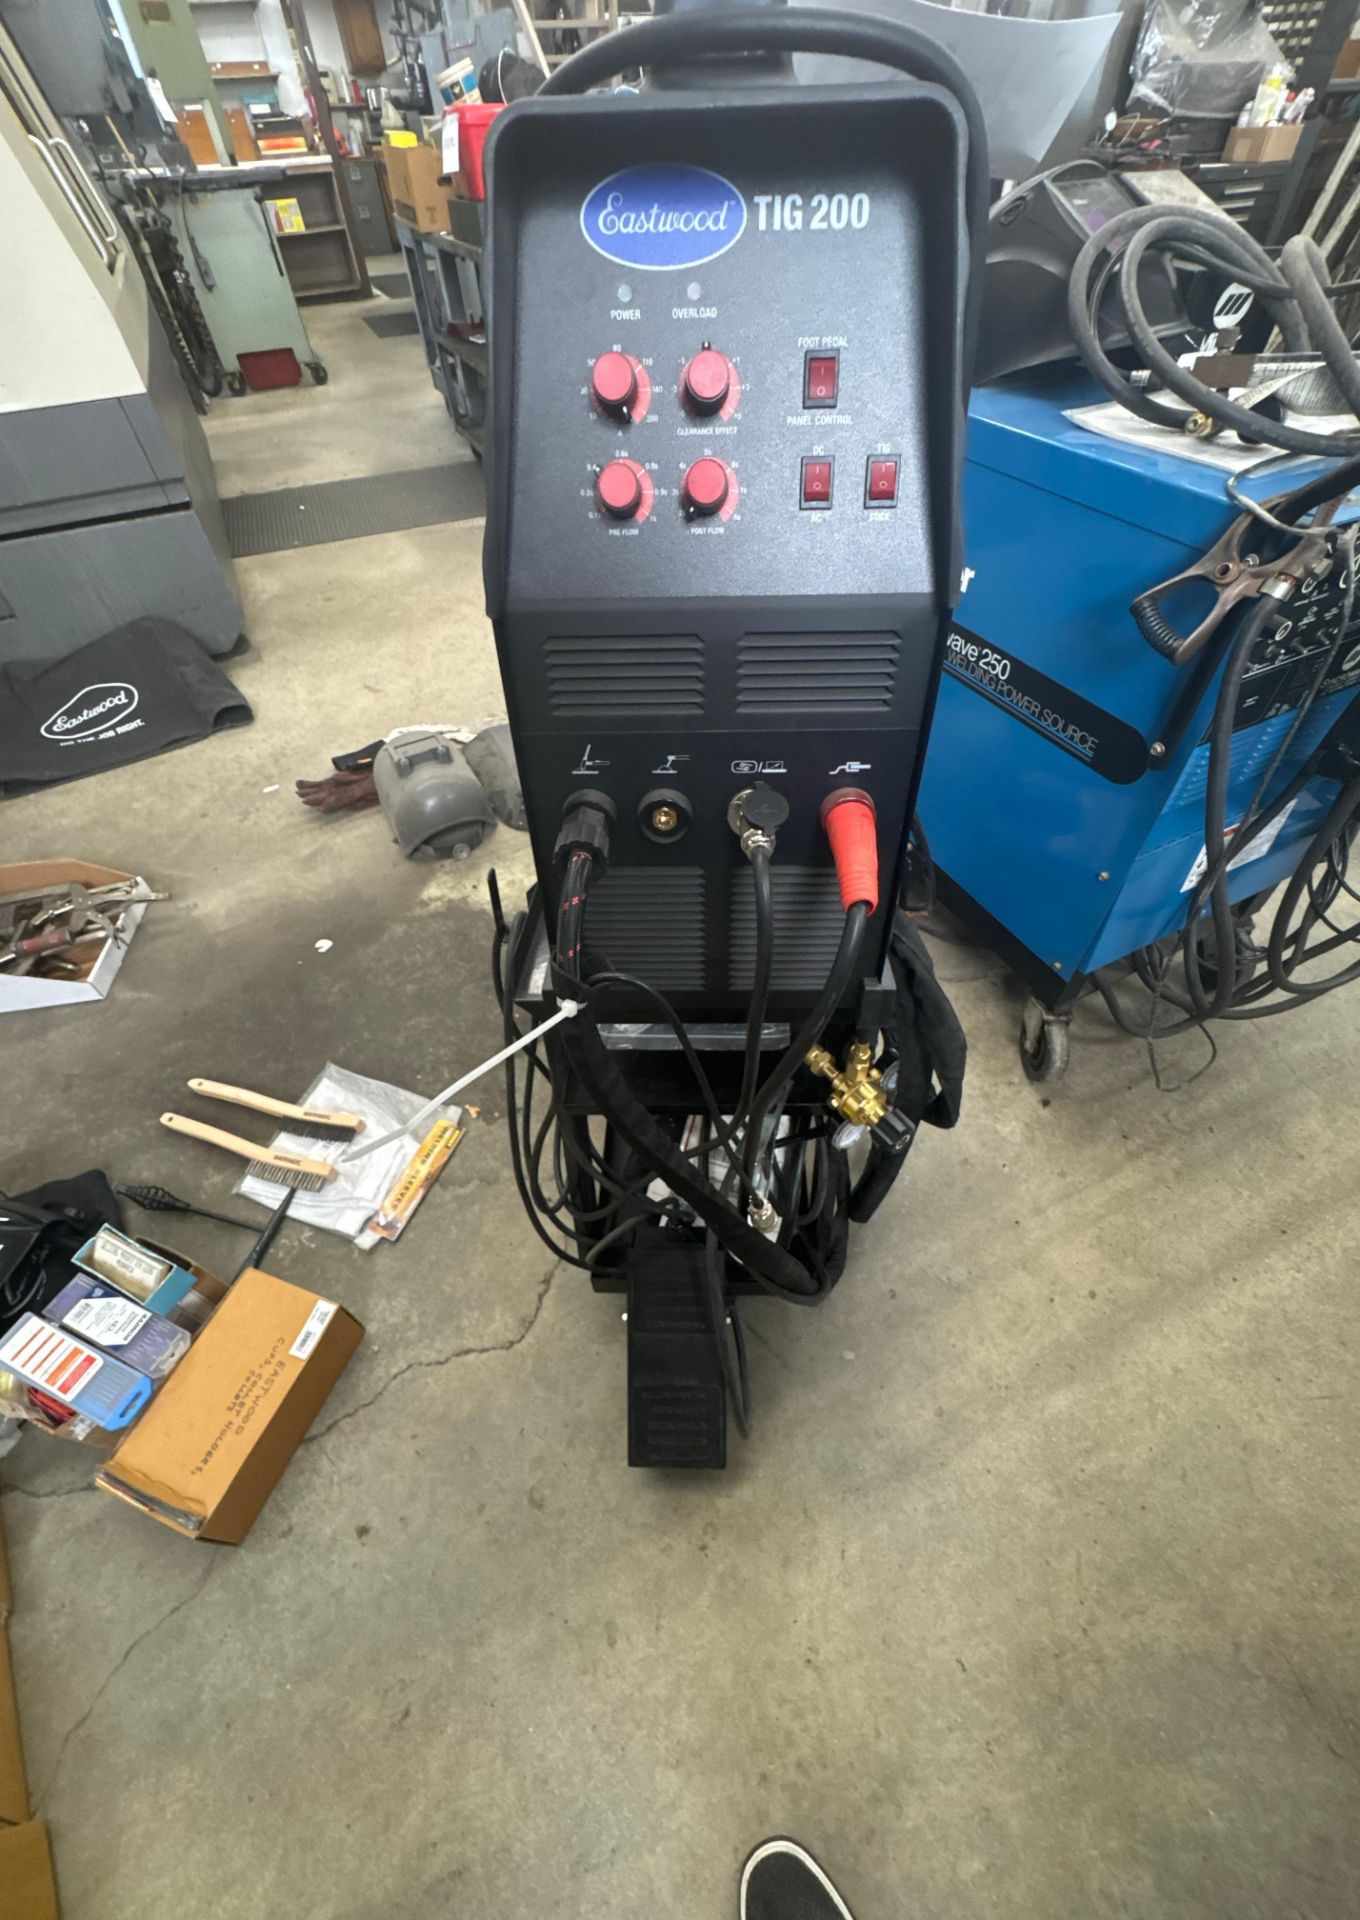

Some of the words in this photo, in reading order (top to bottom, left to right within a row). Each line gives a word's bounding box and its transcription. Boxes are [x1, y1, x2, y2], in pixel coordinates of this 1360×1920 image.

[598, 192, 729, 235] Eastwood
[754, 194, 803, 231] TIG
[810, 193, 870, 230] 200
[610, 309, 641, 320] POWER
[672, 307, 717, 319] OVERLOAD
[798, 337, 820, 348] FOOT
[822, 336, 848, 347] PEDAL
[786, 416, 812, 425] PANEL
[815, 415, 853, 425] CONTROL
[677, 427, 713, 435] CLEARANCE
[715, 426, 738, 434] EFFECT
[813, 445, 825, 456] DC
[877, 443, 892, 453] TIG
[811, 513, 822, 523] AC
[622, 528, 639, 536] FLOW
[708, 527, 725, 535] FLOW
[979, 648, 1011, 680] 250
[948, 652, 996, 691] WELDING
[997, 680, 1041, 717] POWER
[1040, 708, 1099, 752] SOURCE
[52, 690, 129, 732] Eastwood
[97, 730, 116, 740] JOB
[116, 719, 145, 734] RIGHT.
[235, 1360, 286, 1436] EASTWOOD
